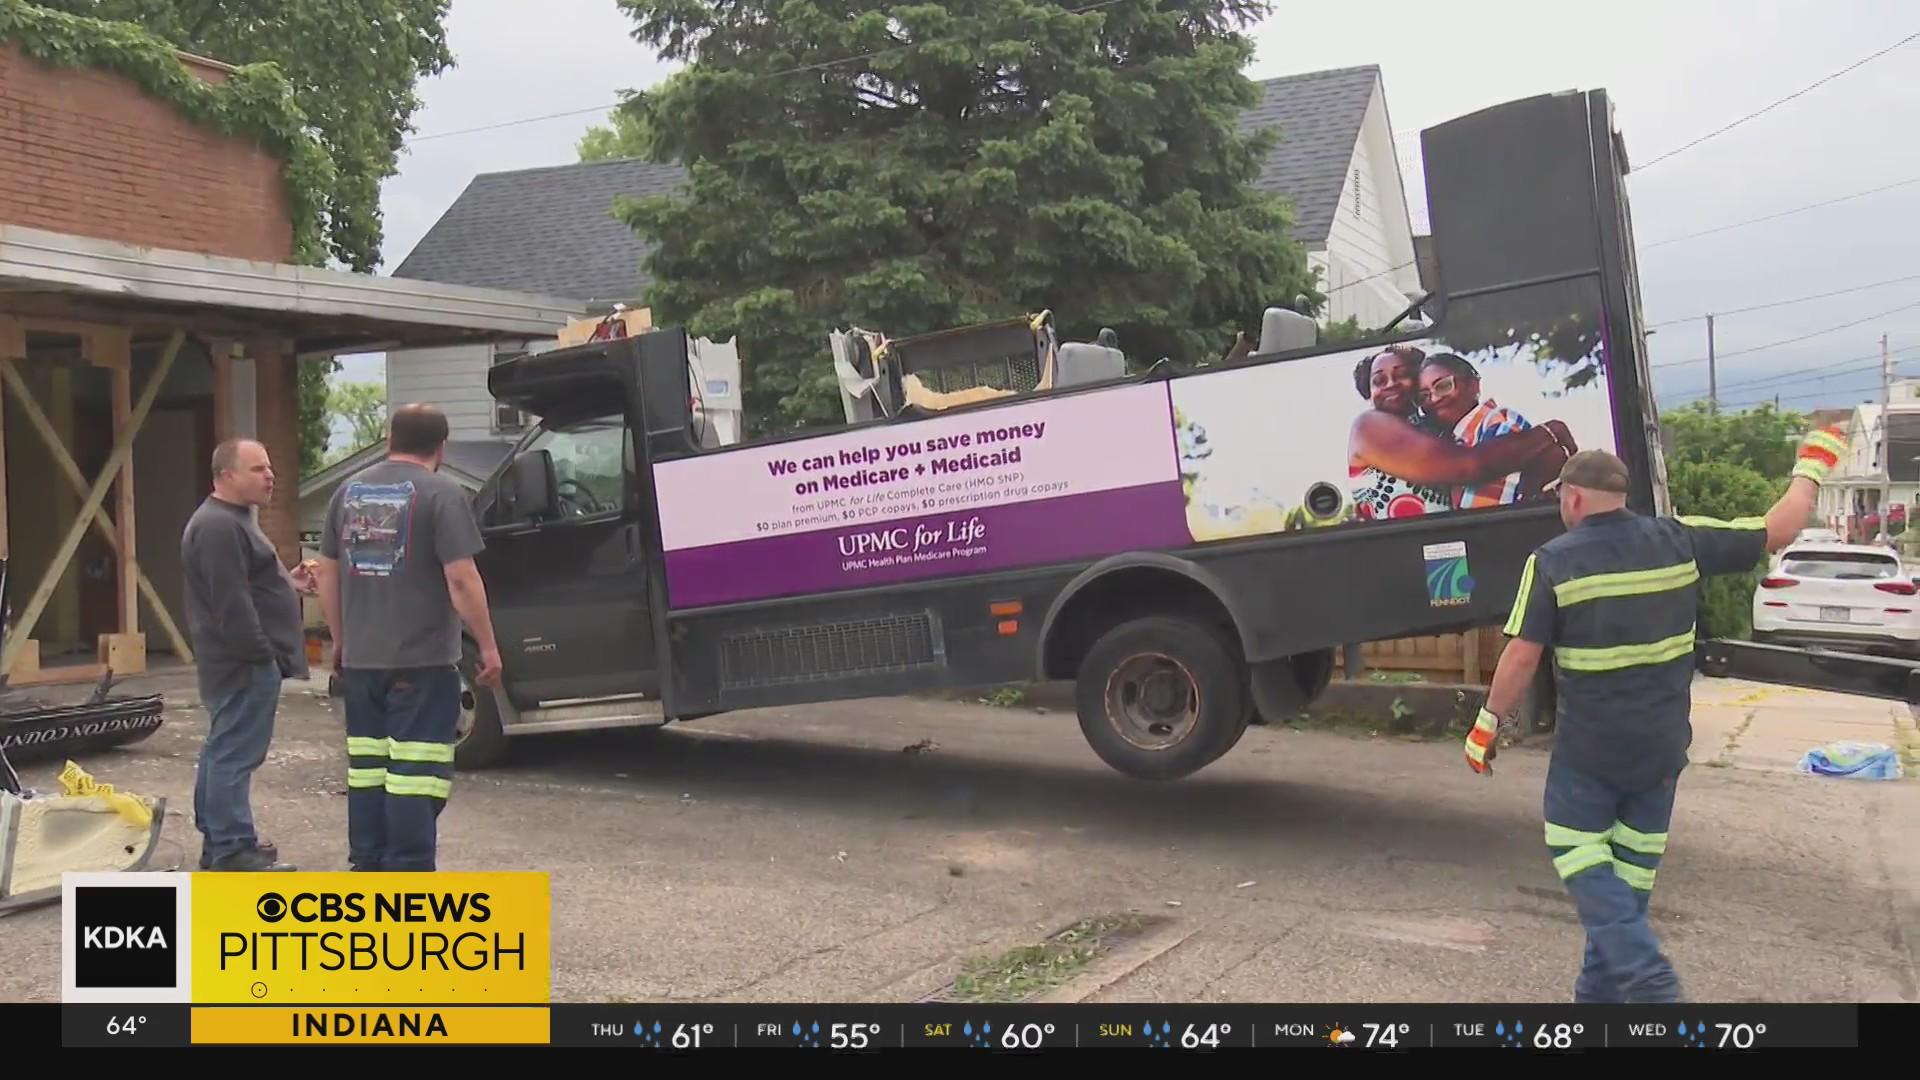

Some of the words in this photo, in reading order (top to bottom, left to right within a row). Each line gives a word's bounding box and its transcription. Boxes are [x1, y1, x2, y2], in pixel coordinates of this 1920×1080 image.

[768, 459, 797, 477] We
[802, 456, 835, 471] can
[839, 446, 880, 465] help
[885, 441, 922, 462] you
[926, 433, 971, 452] save
[976, 422, 1046, 444] money
[795, 481, 819, 495] on
[823, 467, 909, 492] Medicare
[914, 464, 926, 476] +
[931, 446, 1022, 475] Medicaid
[756, 521, 769, 532] $0
[771, 519, 793, 531] plan
[795, 512, 839, 528] premium,
[842, 509, 856, 520] $0
[858, 507, 878, 518] PCP
[881, 502, 919, 516] copays,
[921, 498, 936, 509] $0
[938, 489, 1001, 508] prescription
[1003, 485, 1028, 499] drug
[1031, 480, 1069, 496] copays
[792, 503, 815, 514] from
[817, 498, 847, 511] UPMC
[849, 495, 865, 506] for
[866, 492, 885, 504] Life
[886, 484, 935, 500] Complete
[938, 481, 962, 493] Care
[964, 476, 995, 490] (HMO
[999, 472, 1025, 485] SNP)
[838, 528, 909, 556] UPMC
[913, 524, 942, 552] for
[946, 516, 986, 546] Life
[842, 559, 868, 571] UPMC
[868, 556, 895, 568] Health
[895, 553, 913, 565] Plan
[913, 549, 951, 562] Medicare
[952, 545, 987, 559] Program
